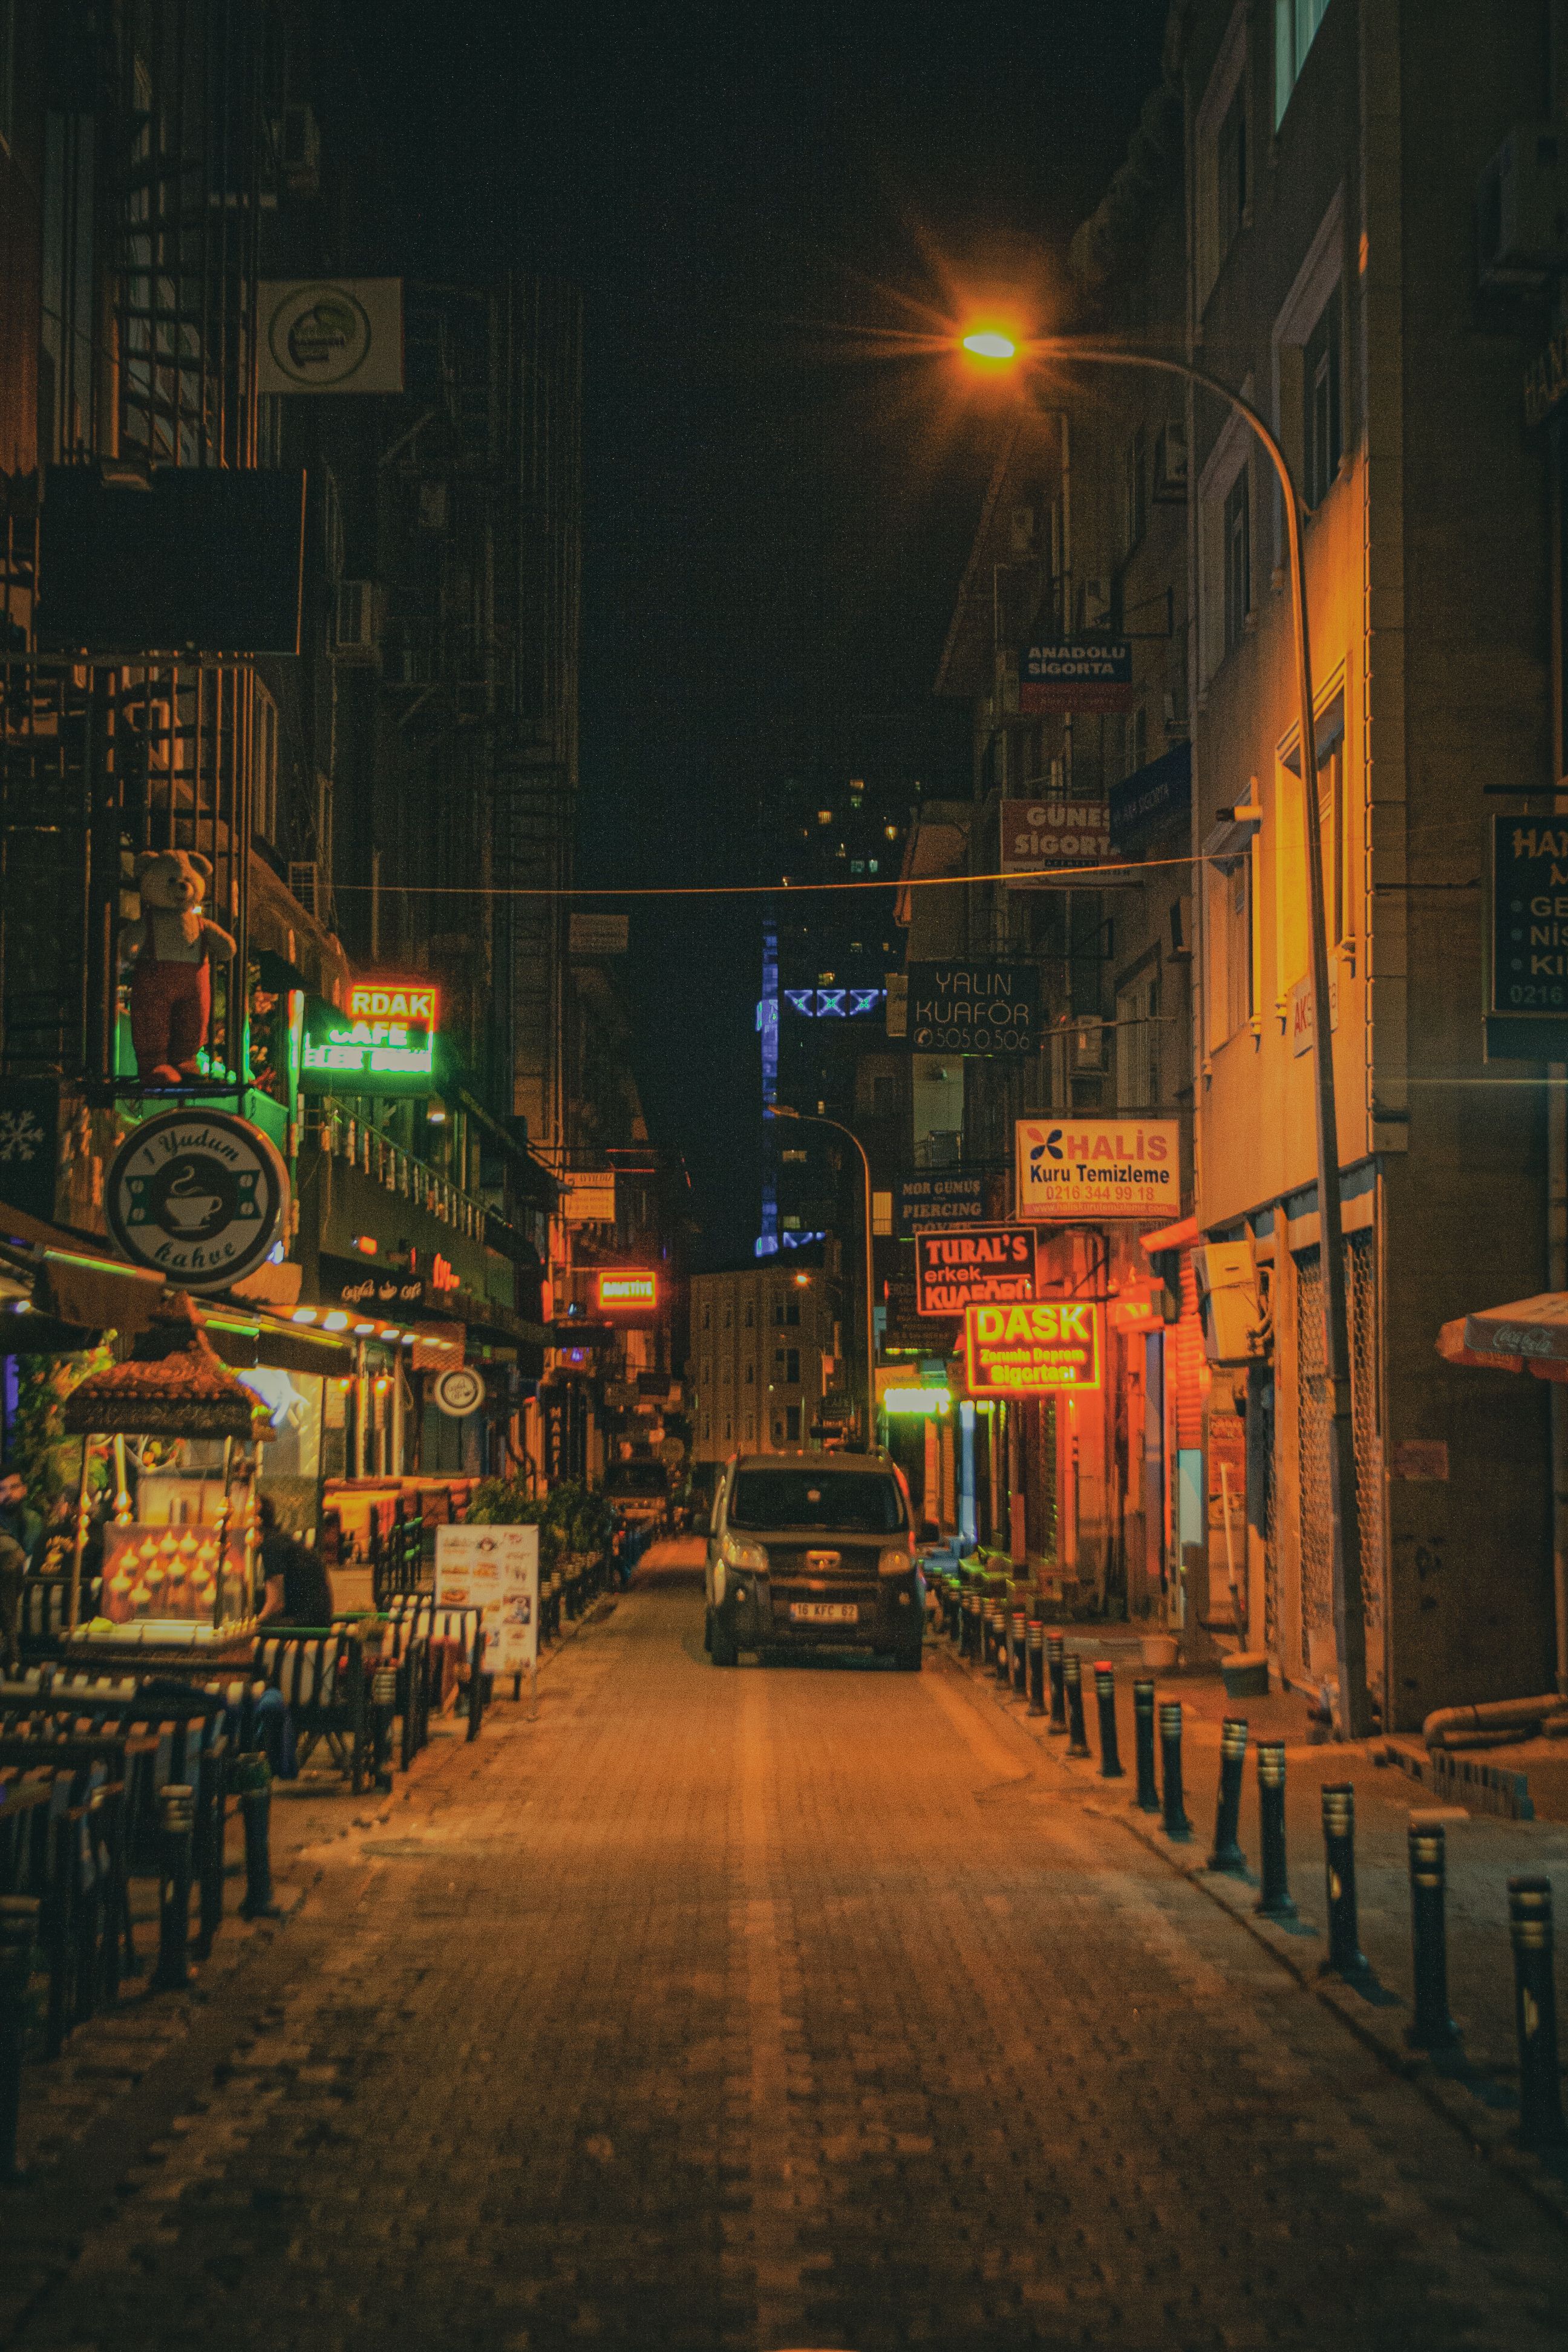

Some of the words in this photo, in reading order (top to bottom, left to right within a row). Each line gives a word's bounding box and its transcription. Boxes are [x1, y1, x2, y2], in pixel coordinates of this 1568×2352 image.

[1028, 647, 1126, 659] ANADOLU
[1028, 659, 1114, 675] SİGORTA
[935, 972, 1011, 995] YALIN
[1510, 984, 1564, 1004] 0216
[916, 1000, 1029, 1025] KUAFÖR
[158, 1129, 239, 1161] Yudum
[1066, 1129, 1168, 1161] HALİS
[1030, 1165, 1071, 1183] Kuru
[1076, 1164, 1170, 1183] Temizleme
[903, 1181, 931, 1196] MOR
[1045, 1186, 1080, 1200] 0216
[1084, 1186, 1111, 1200] 344
[1114, 1186, 1132, 1200] 99
[1137, 1186, 1155, 1200] 18
[902, 1202, 981, 1218] PIERCING
[926, 1234, 1028, 1264] TURAL'S
[924, 1266, 982, 1283] erkek
[978, 1305, 1088, 1341] DASK
[1033, 1347, 1085, 1365] Deprem
